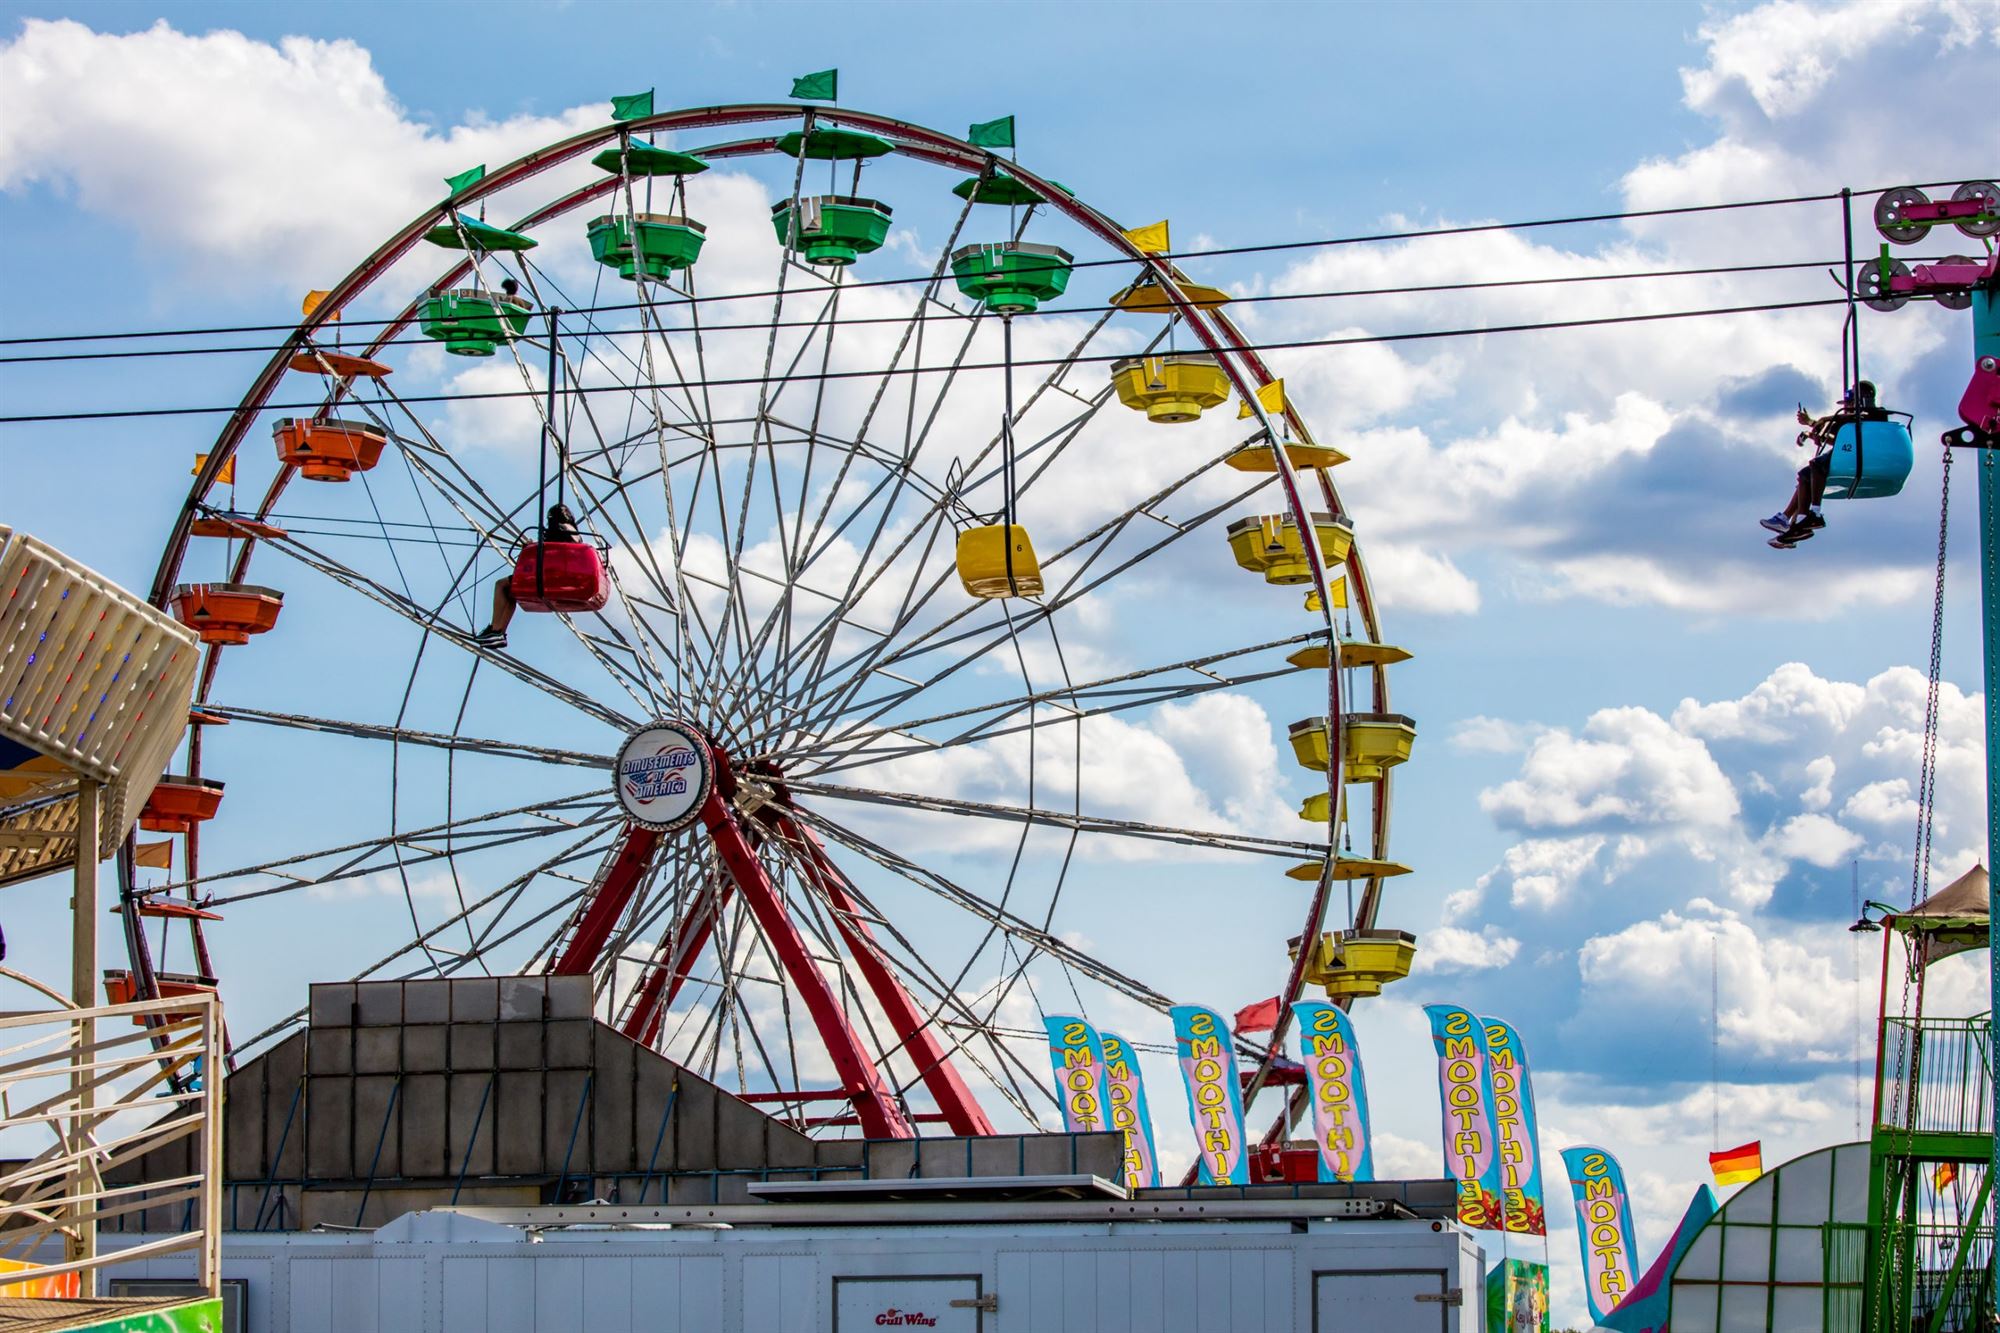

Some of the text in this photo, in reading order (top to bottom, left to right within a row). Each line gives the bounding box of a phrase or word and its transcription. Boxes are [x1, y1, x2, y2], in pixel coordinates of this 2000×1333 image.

[1841, 443, 1853, 453] 42
[1016, 544, 1023, 552] 6
[621, 751, 697, 775] AMUSEMENTS
[653, 770, 665, 782] OF
[635, 780, 688, 799] AMERICA
[904, 1311, 936, 1327] Wing
